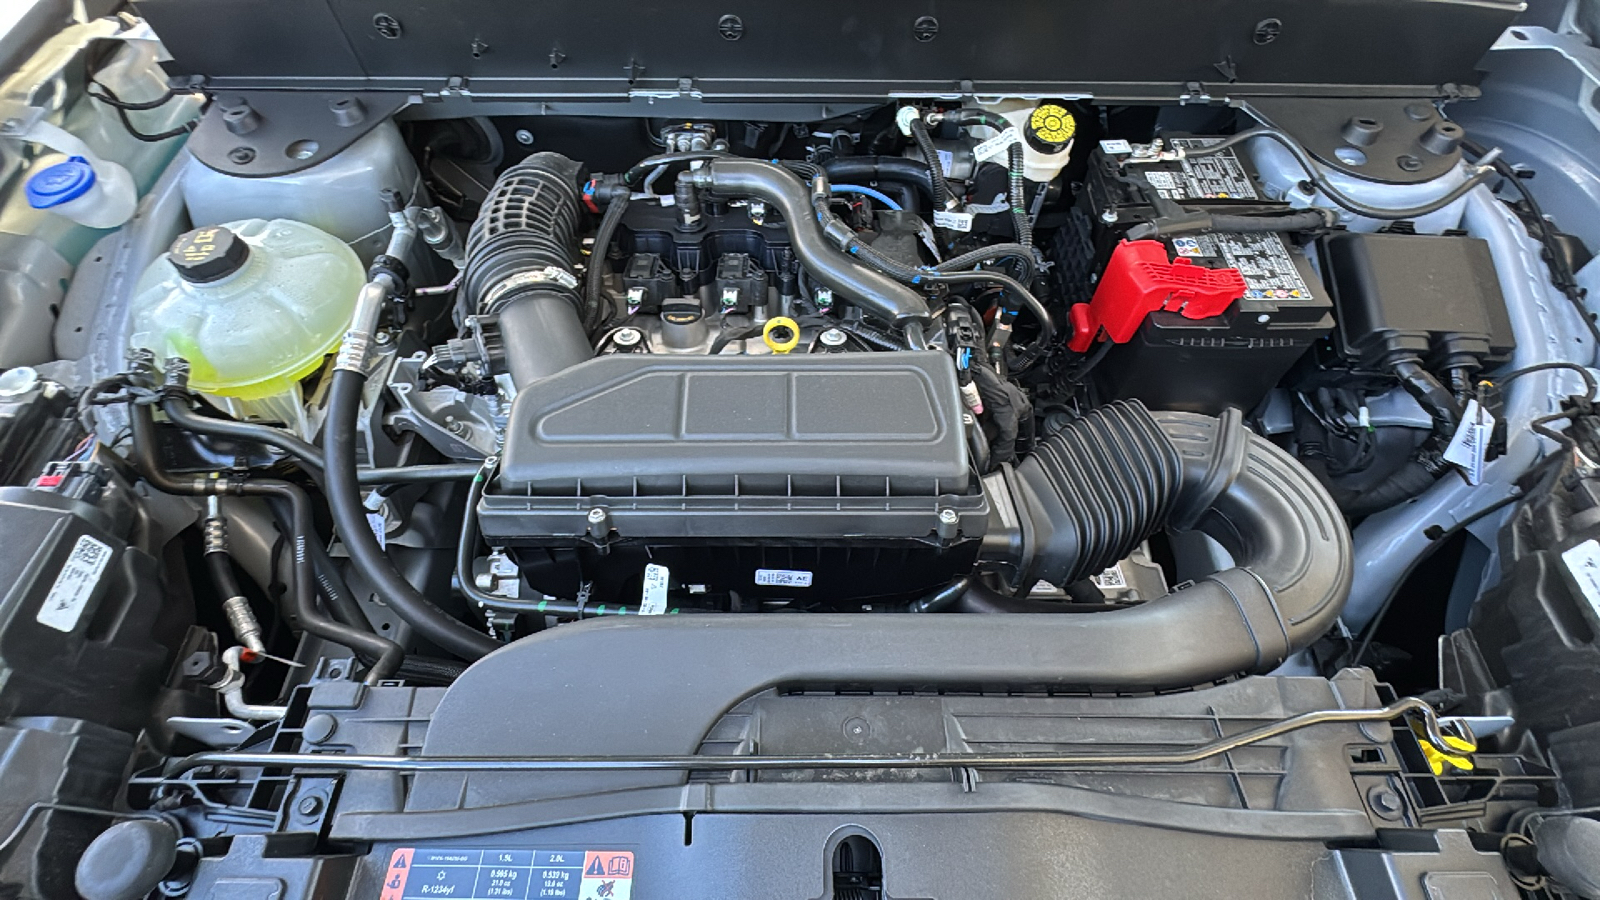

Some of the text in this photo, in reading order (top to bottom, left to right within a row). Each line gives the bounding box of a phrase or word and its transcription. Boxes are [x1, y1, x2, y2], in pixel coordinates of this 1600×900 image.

[508, 869, 518, 881] kg
[560, 871, 570, 881] kg
[421, 884, 456, 896] R-1234yf
